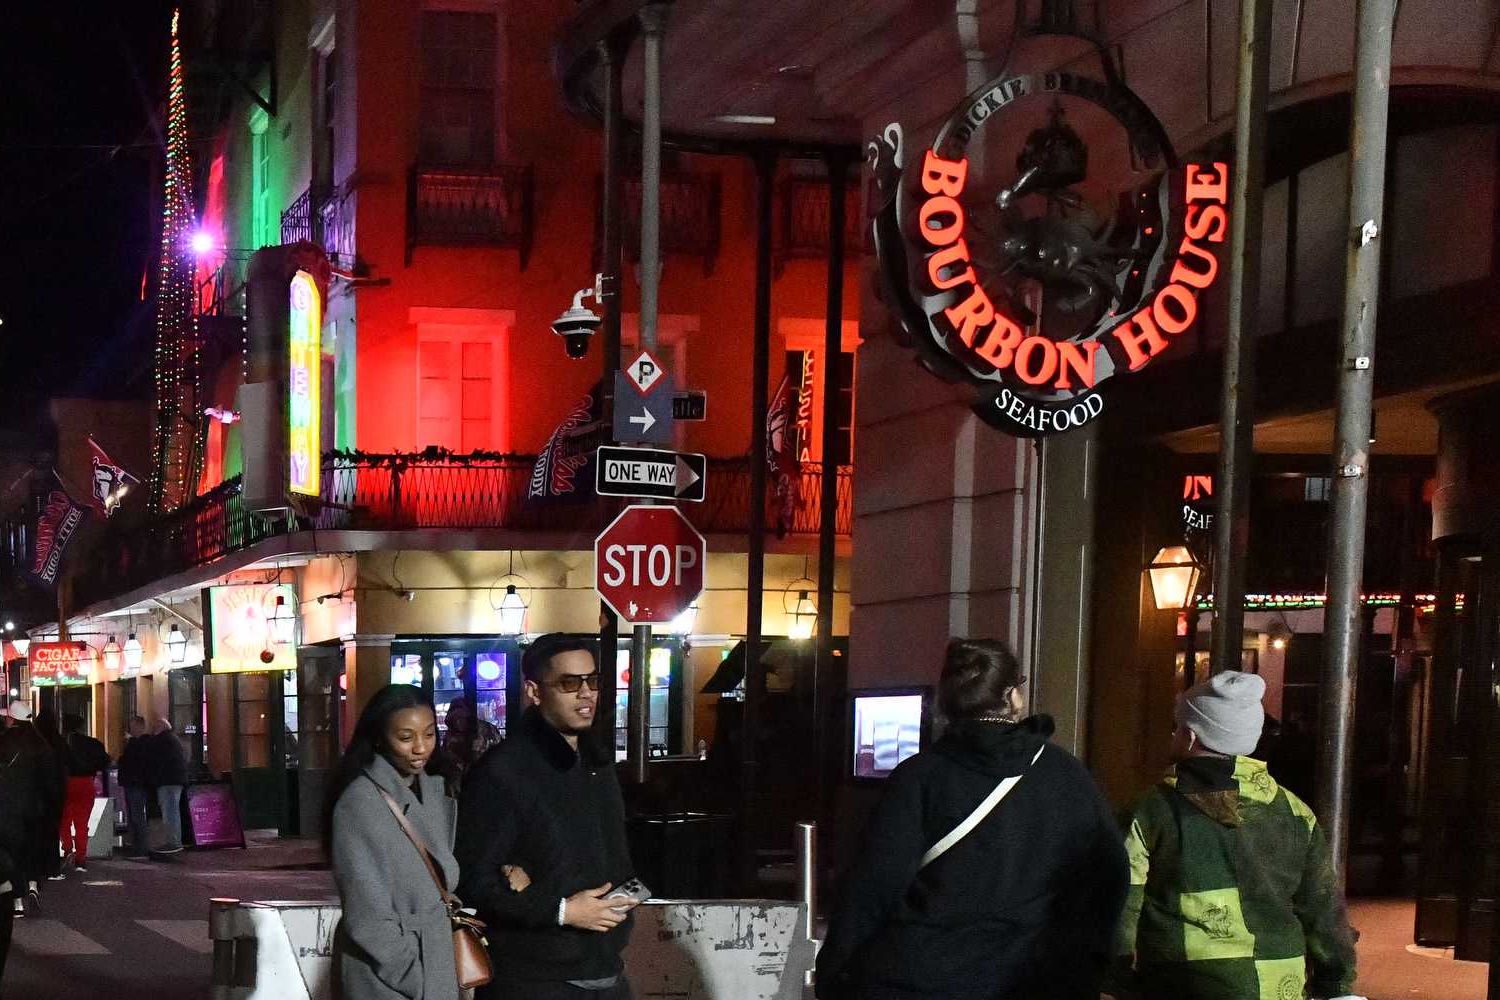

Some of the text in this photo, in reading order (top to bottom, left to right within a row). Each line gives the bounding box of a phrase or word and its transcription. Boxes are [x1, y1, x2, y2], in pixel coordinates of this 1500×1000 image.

[919, 149, 1228, 389] BOURBON HOUSE
[995, 388, 1103, 431] SEAFOOD
[608, 462, 675, 484] ONE WAY
[603, 544, 697, 587] STOP
[33, 660, 80, 673] FACTOR
